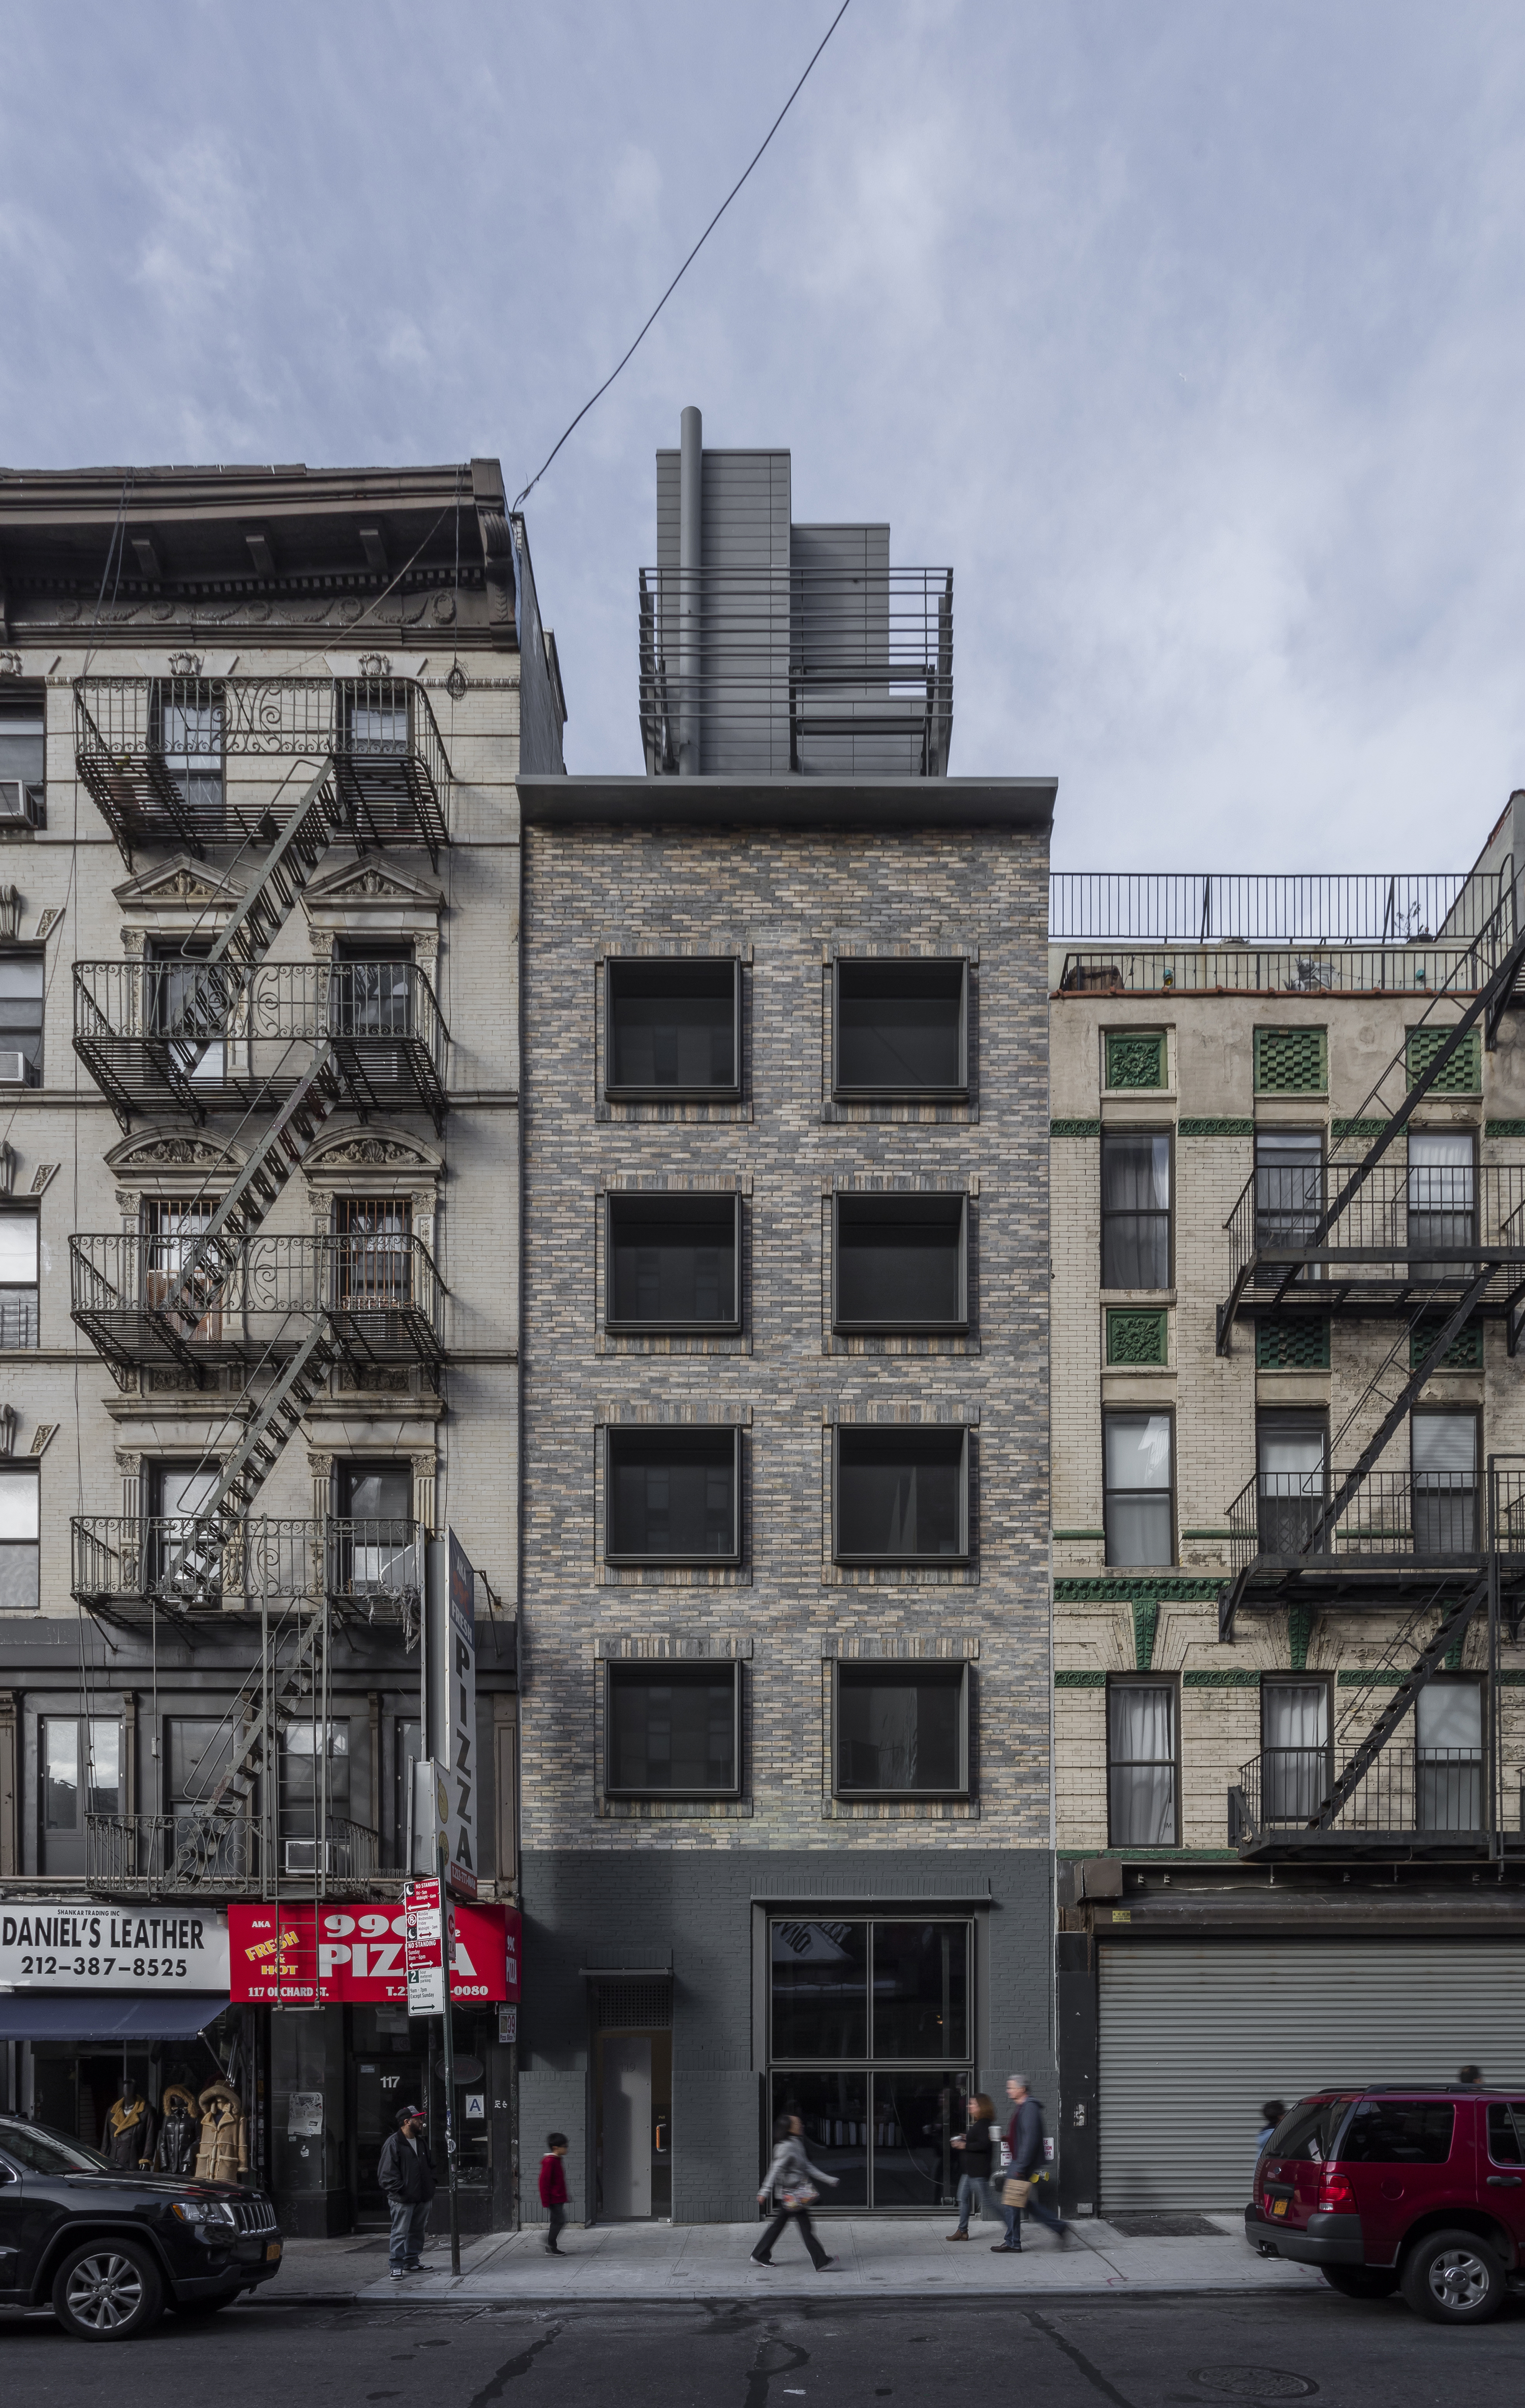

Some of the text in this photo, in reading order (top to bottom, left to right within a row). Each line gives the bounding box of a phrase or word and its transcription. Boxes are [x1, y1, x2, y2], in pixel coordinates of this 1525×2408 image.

[457, 1556, 467, 1586] AKA
[451, 1599, 473, 1644] FRESH
[455, 1632, 473, 1871] PIZZA
[3, 1916, 204, 1949] DANIEL'S LEATHER
[245, 1931, 300, 1961] FRESH
[415, 1940, 436, 1948] STANDING
[21, 1955, 187, 1977] 212-387-8525
[261, 1965, 298, 1975] HOT
[319, 1944, 477, 1977] PIZA
[411, 1971, 416, 1982] 2
[248, 1987, 264, 1997] 117
[380, 2076, 400, 2088] 117
[469, 2098, 481, 2112] A
